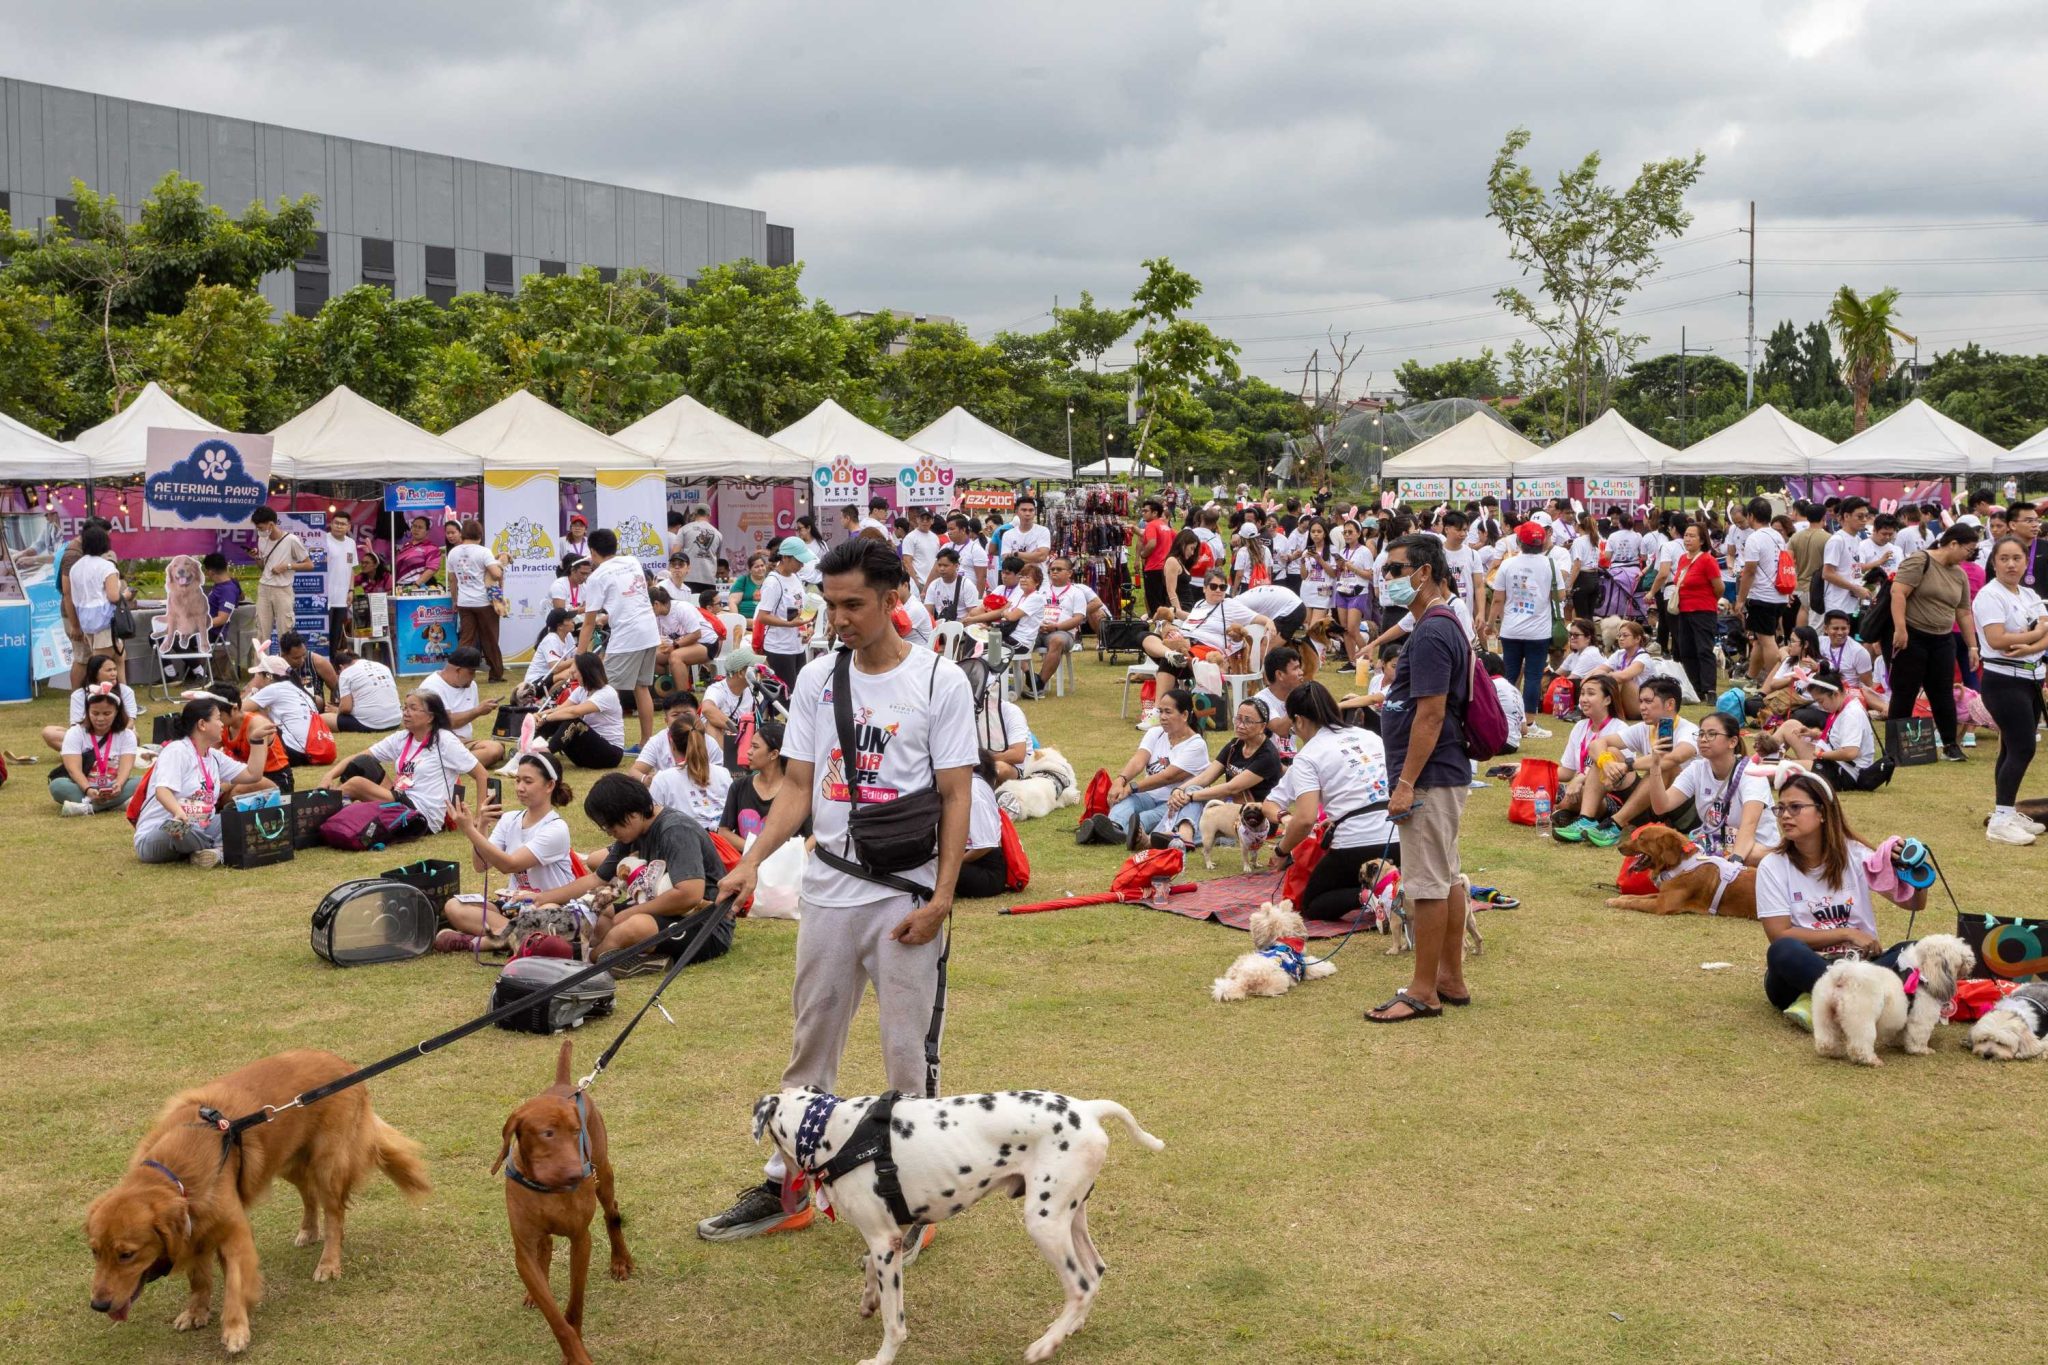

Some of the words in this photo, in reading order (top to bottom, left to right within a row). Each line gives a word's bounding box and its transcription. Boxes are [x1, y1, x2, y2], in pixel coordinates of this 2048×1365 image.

[1416, 481, 1445, 489] dunsk
[1471, 481, 1501, 489] dunsk
[1531, 480, 1561, 488] dunsk
[1603, 480, 1634, 488] dunsk
[154, 481, 221, 495] AETERNAL
[224, 485, 260, 497] PAWS
[825, 487, 859, 496] PETS
[909, 487, 945, 496] PETS
[1413, 489, 1447, 498] kuhner
[1468, 488, 1503, 497] kuhner
[1529, 488, 1565, 497] kuhner
[1600, 487, 1637, 496] kuhner
[966, 494, 1012, 505] EZYDOG
[511, 564, 520, 572] In
[522, 563, 557, 572] Practice
[642, 561, 667, 570] actice
